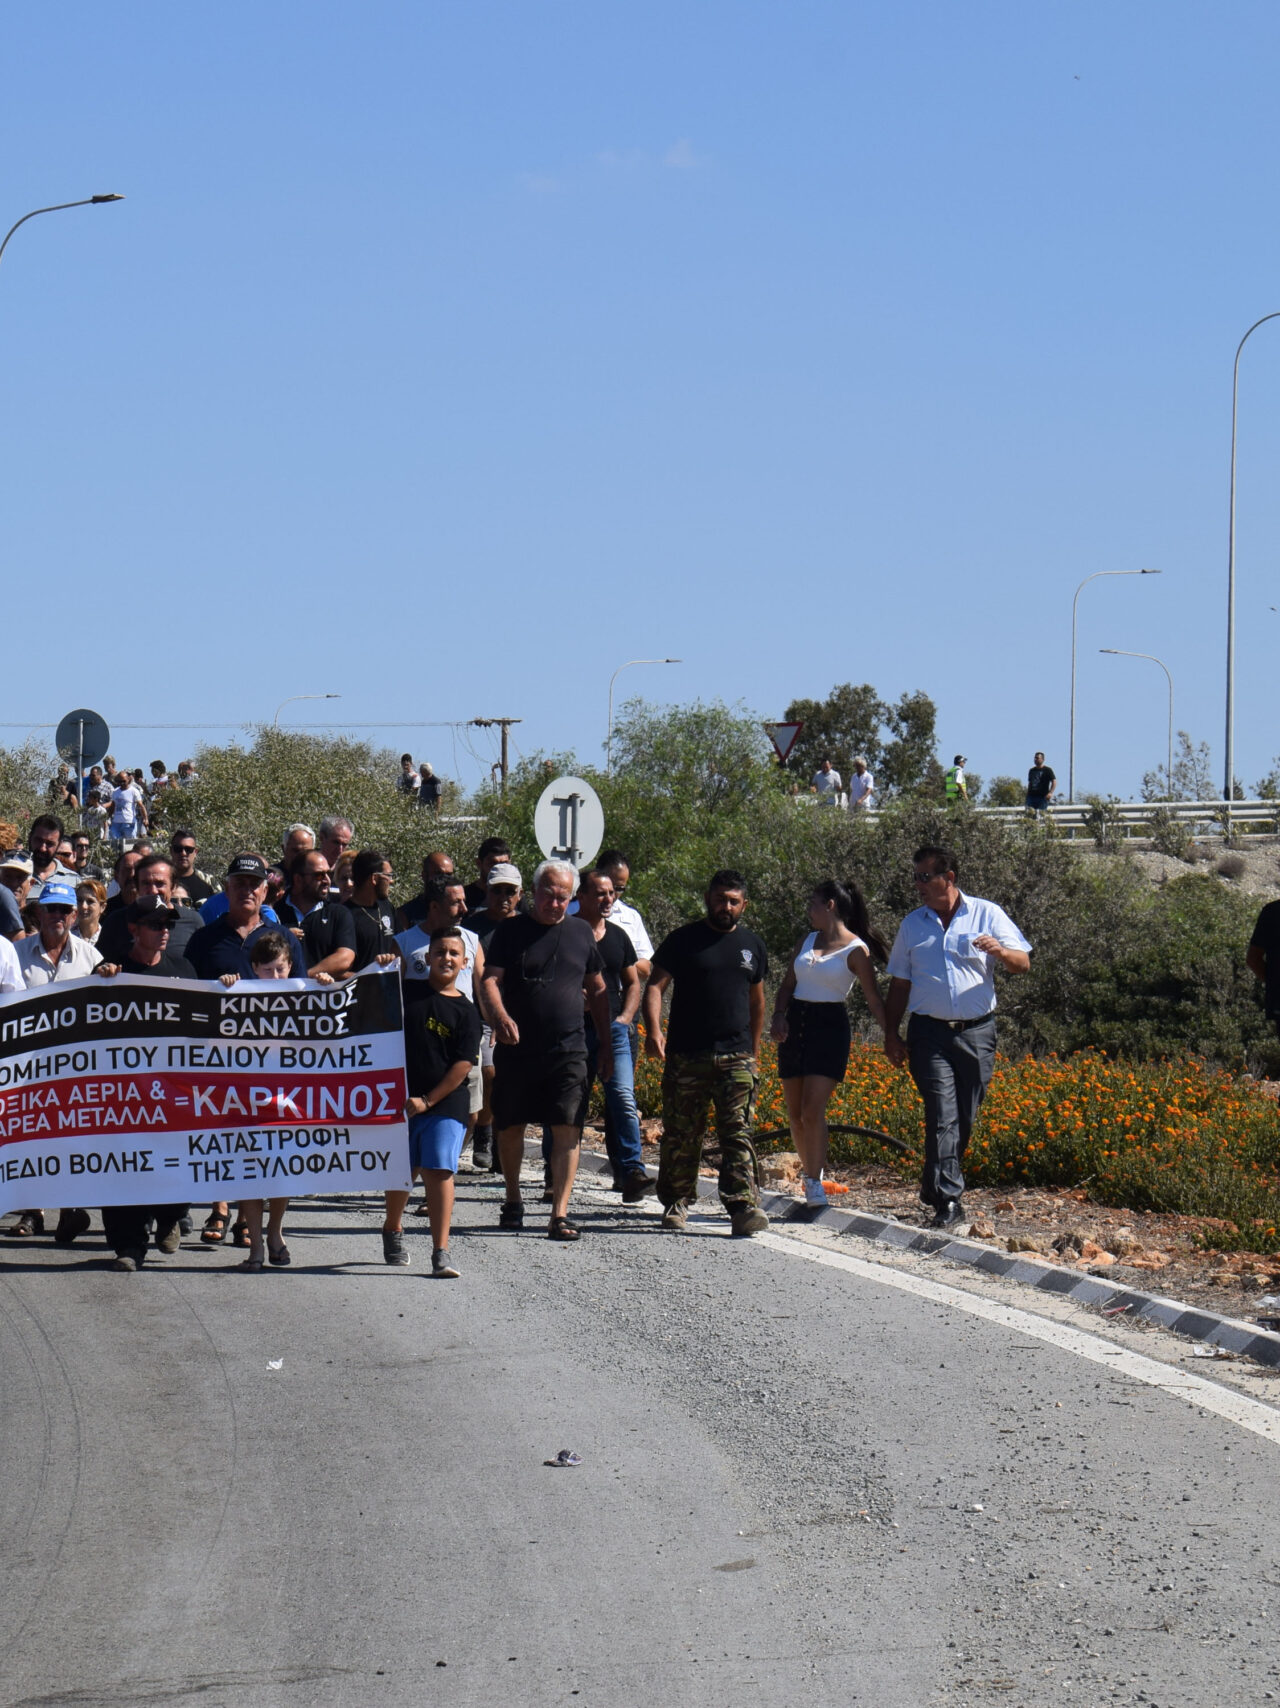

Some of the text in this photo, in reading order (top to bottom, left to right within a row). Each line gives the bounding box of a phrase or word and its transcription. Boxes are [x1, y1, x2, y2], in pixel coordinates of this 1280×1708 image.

[220, 979, 358, 1015] ΚΙΝΔΥΝΟΣ
[1, 1001, 209, 1042] ΠΕΔΙΟ ΒΟΛΗΣ =
[220, 1012, 349, 1037] ΘΑΝΑΤΟΣ
[106, 1046, 158, 1069] ΤΟΥ
[167, 1045, 271, 1068] ΠΕΔΙΟΥ
[280, 1044, 373, 1068] ΒΟΛΗΣ
[68, 1081, 141, 1105] ΑΕΡΙΑ
[149, 1080, 166, 1100] &
[174, 1082, 397, 1119] = ΚΑΡΚΙΝΟΣ
[58, 1105, 168, 1130] ΜΕΤΑΛΛΑ
[188, 1127, 351, 1156] ΚΑΤΑΣΤΡΟΦΗ
[70, 1150, 154, 1175] ΒΟΛΗΣ
[164, 1157, 180, 1168] =
[188, 1151, 391, 1183] ΤΗΣ ΞΥΛΟΦΑΓΟΥ
